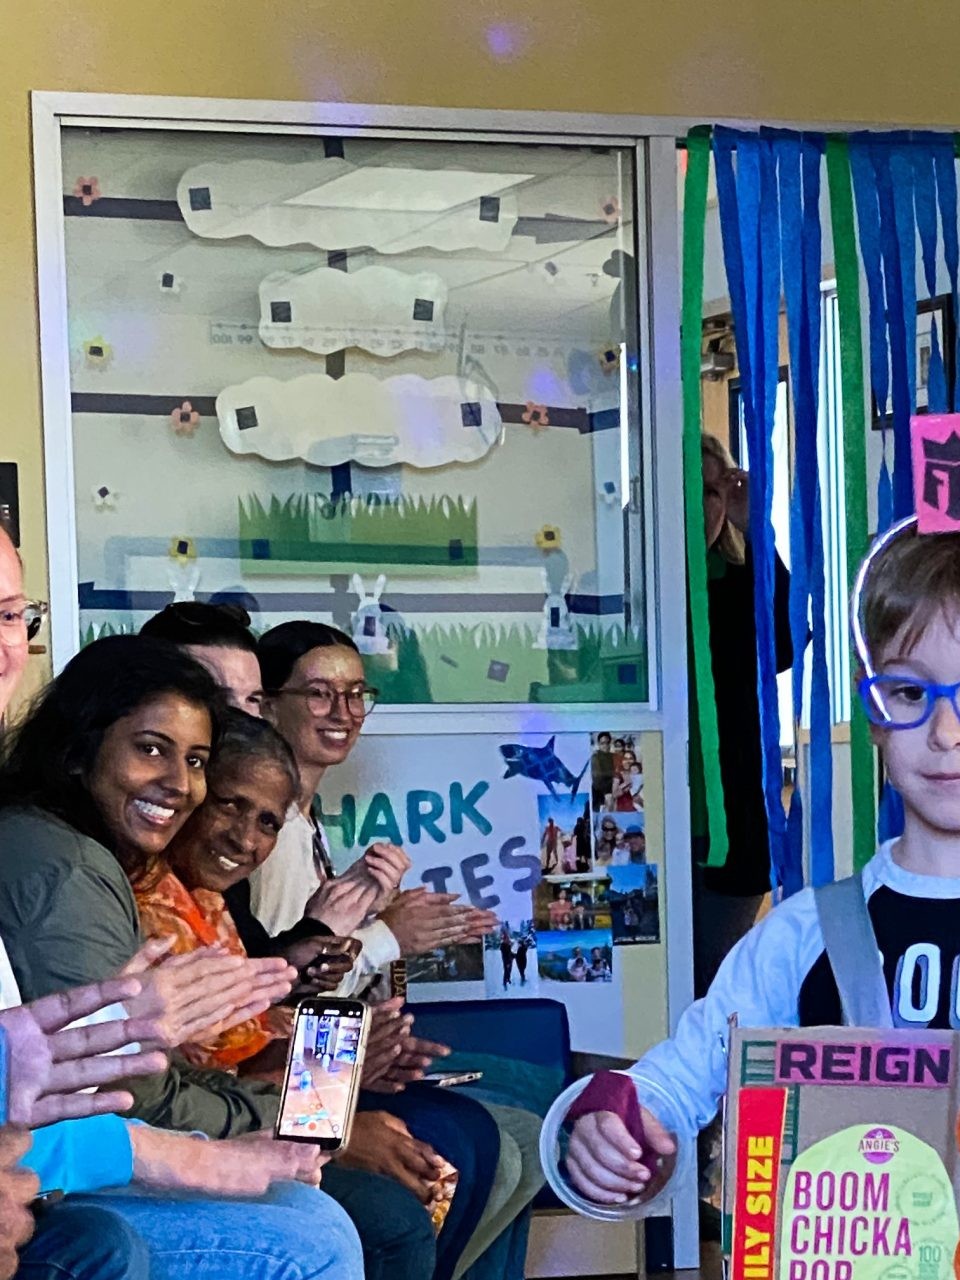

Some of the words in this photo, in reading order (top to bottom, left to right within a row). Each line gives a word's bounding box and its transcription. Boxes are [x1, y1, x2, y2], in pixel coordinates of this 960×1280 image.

[314, 780, 493, 849] HARK
[420, 835, 542, 911] TES
[778, 1043, 950, 1084] REIGN
[858, 1139, 900, 1152] ANGIE'S
[745, 1135, 774, 1217] SIZE
[793, 1171, 890, 1212] BOOM
[790, 1214, 912, 1257] CHICKA
